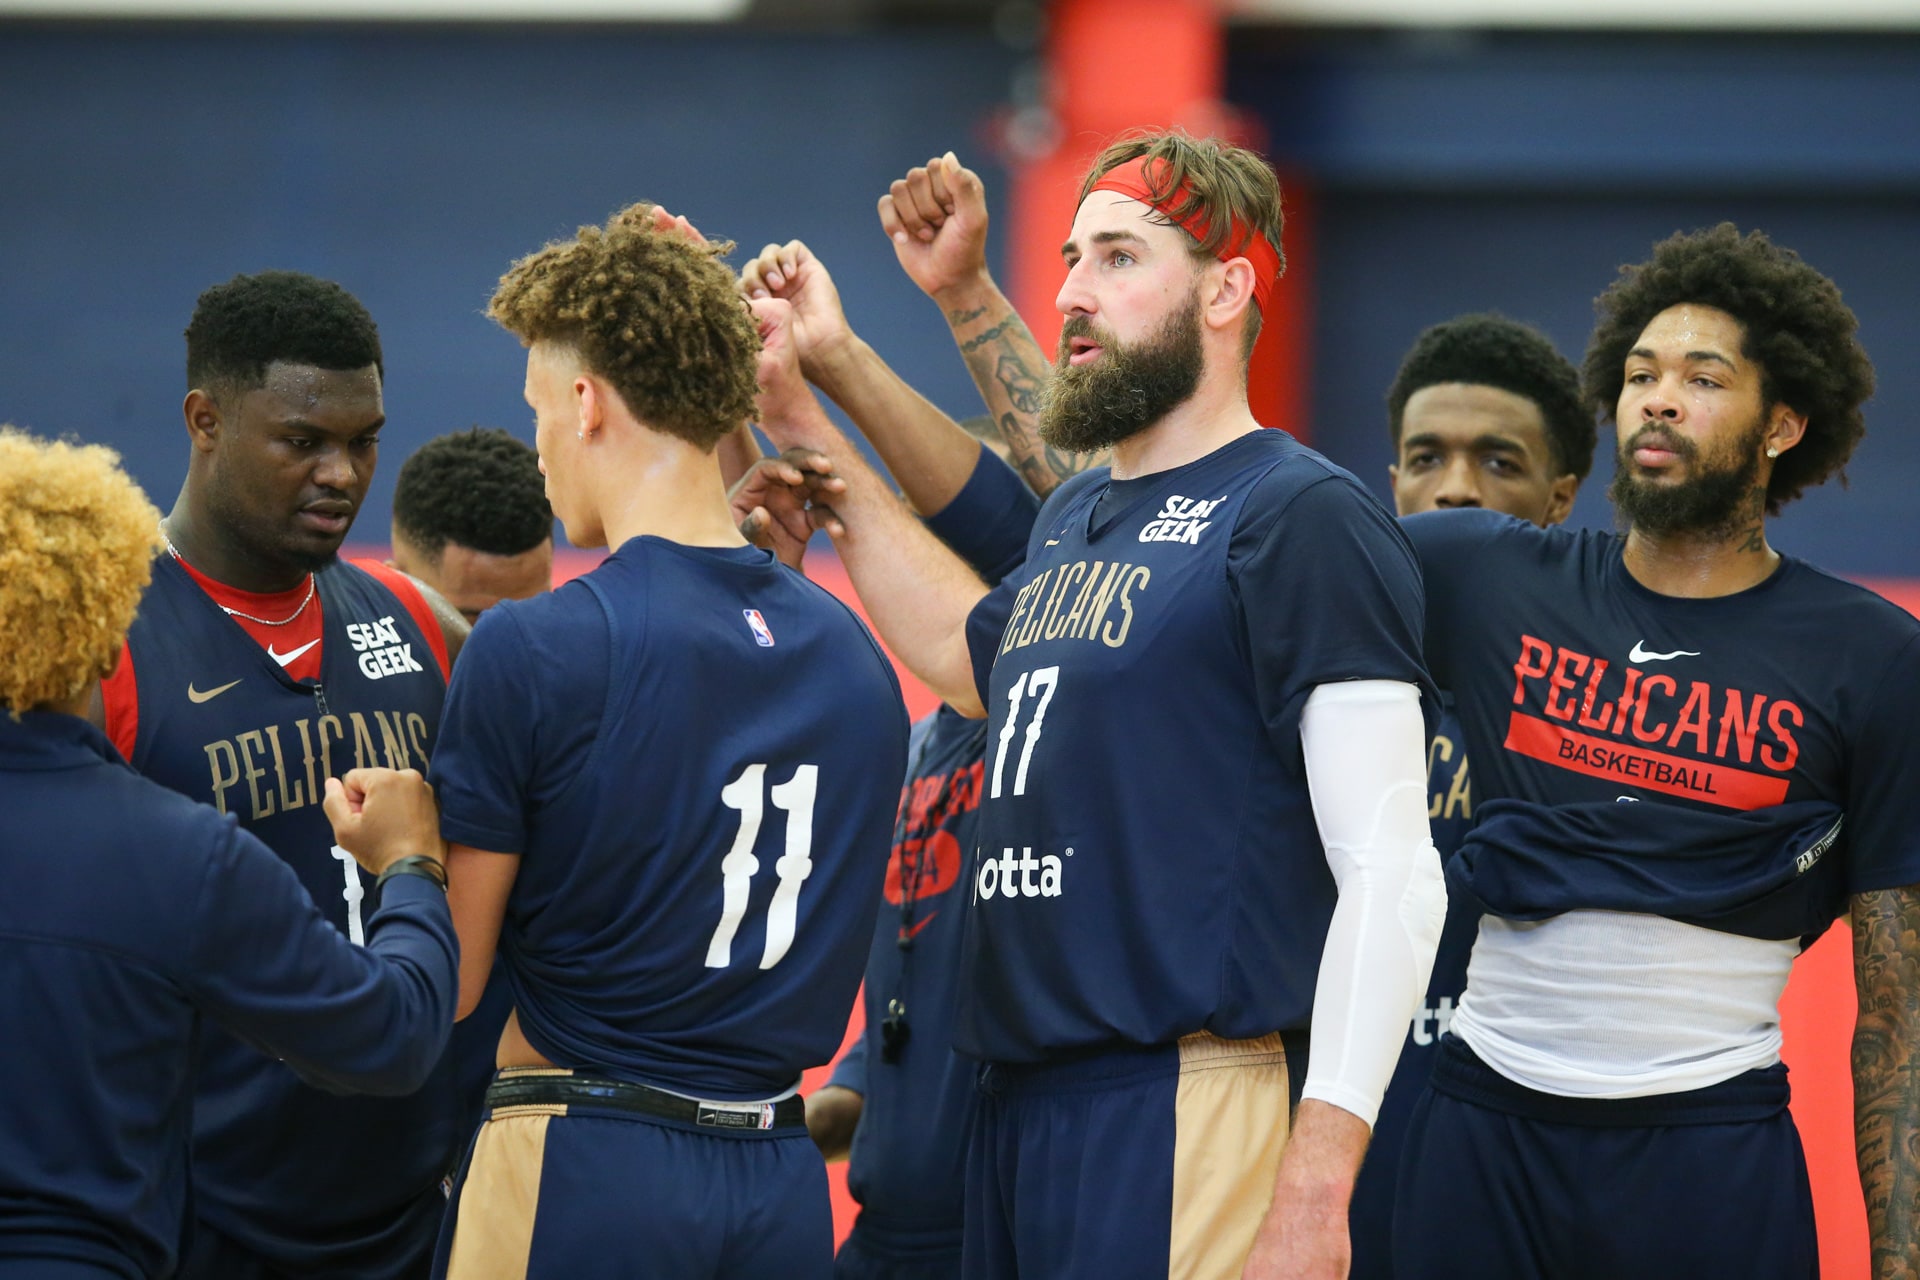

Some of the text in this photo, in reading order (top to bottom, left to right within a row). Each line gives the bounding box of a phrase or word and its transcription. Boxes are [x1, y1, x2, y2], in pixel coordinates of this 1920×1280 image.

[1157, 495, 1227, 519] SEAT
[1139, 518, 1212, 545] GEEK
[346, 616, 402, 651] SEAT
[358, 643, 423, 680] GEEK
[1512, 634, 1804, 771] PELICANS
[990, 665, 1060, 799] 17
[1557, 738, 1717, 794] BASKETBALL
[704, 763, 819, 970] 11
